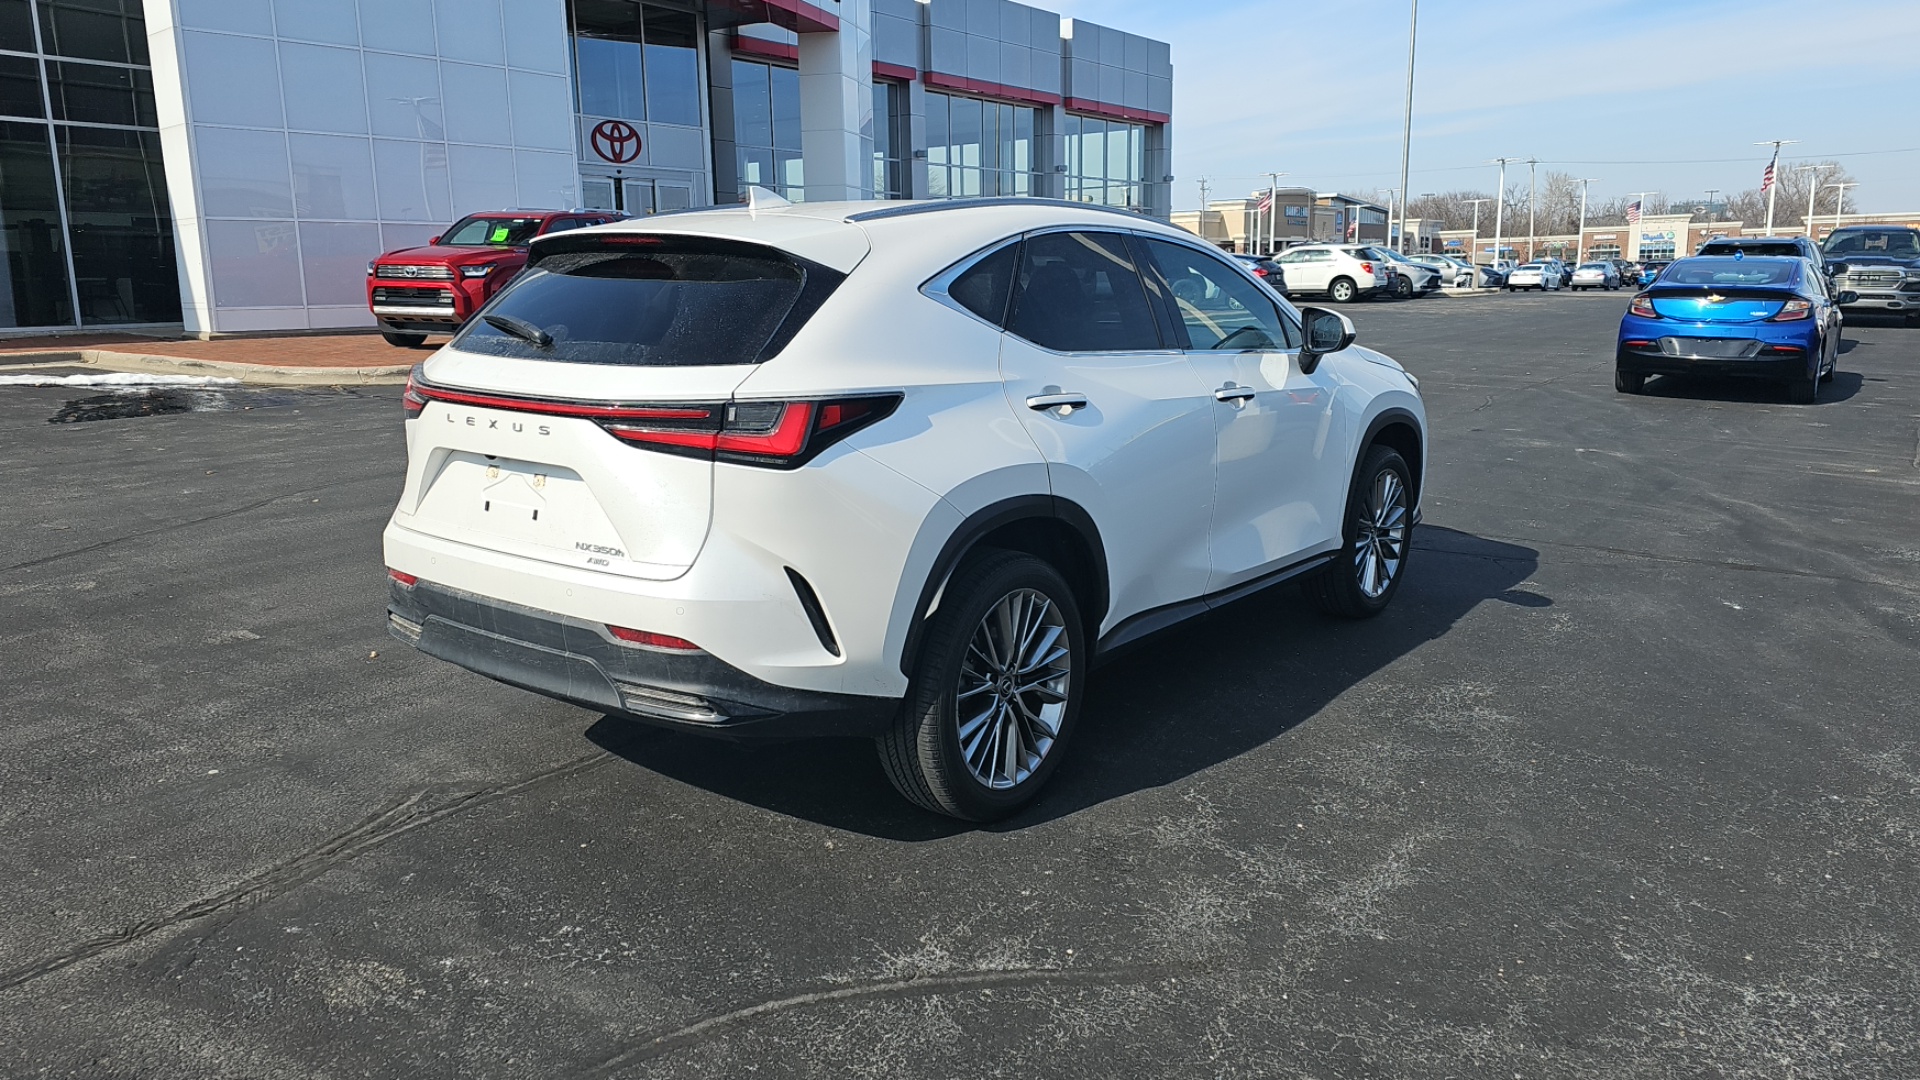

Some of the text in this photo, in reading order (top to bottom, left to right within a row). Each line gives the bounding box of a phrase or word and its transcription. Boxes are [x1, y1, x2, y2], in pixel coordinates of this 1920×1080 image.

[446, 412, 551, 436] LEXUS
[575, 541, 625, 558] NX350h
[586, 557, 610, 567] AWD
